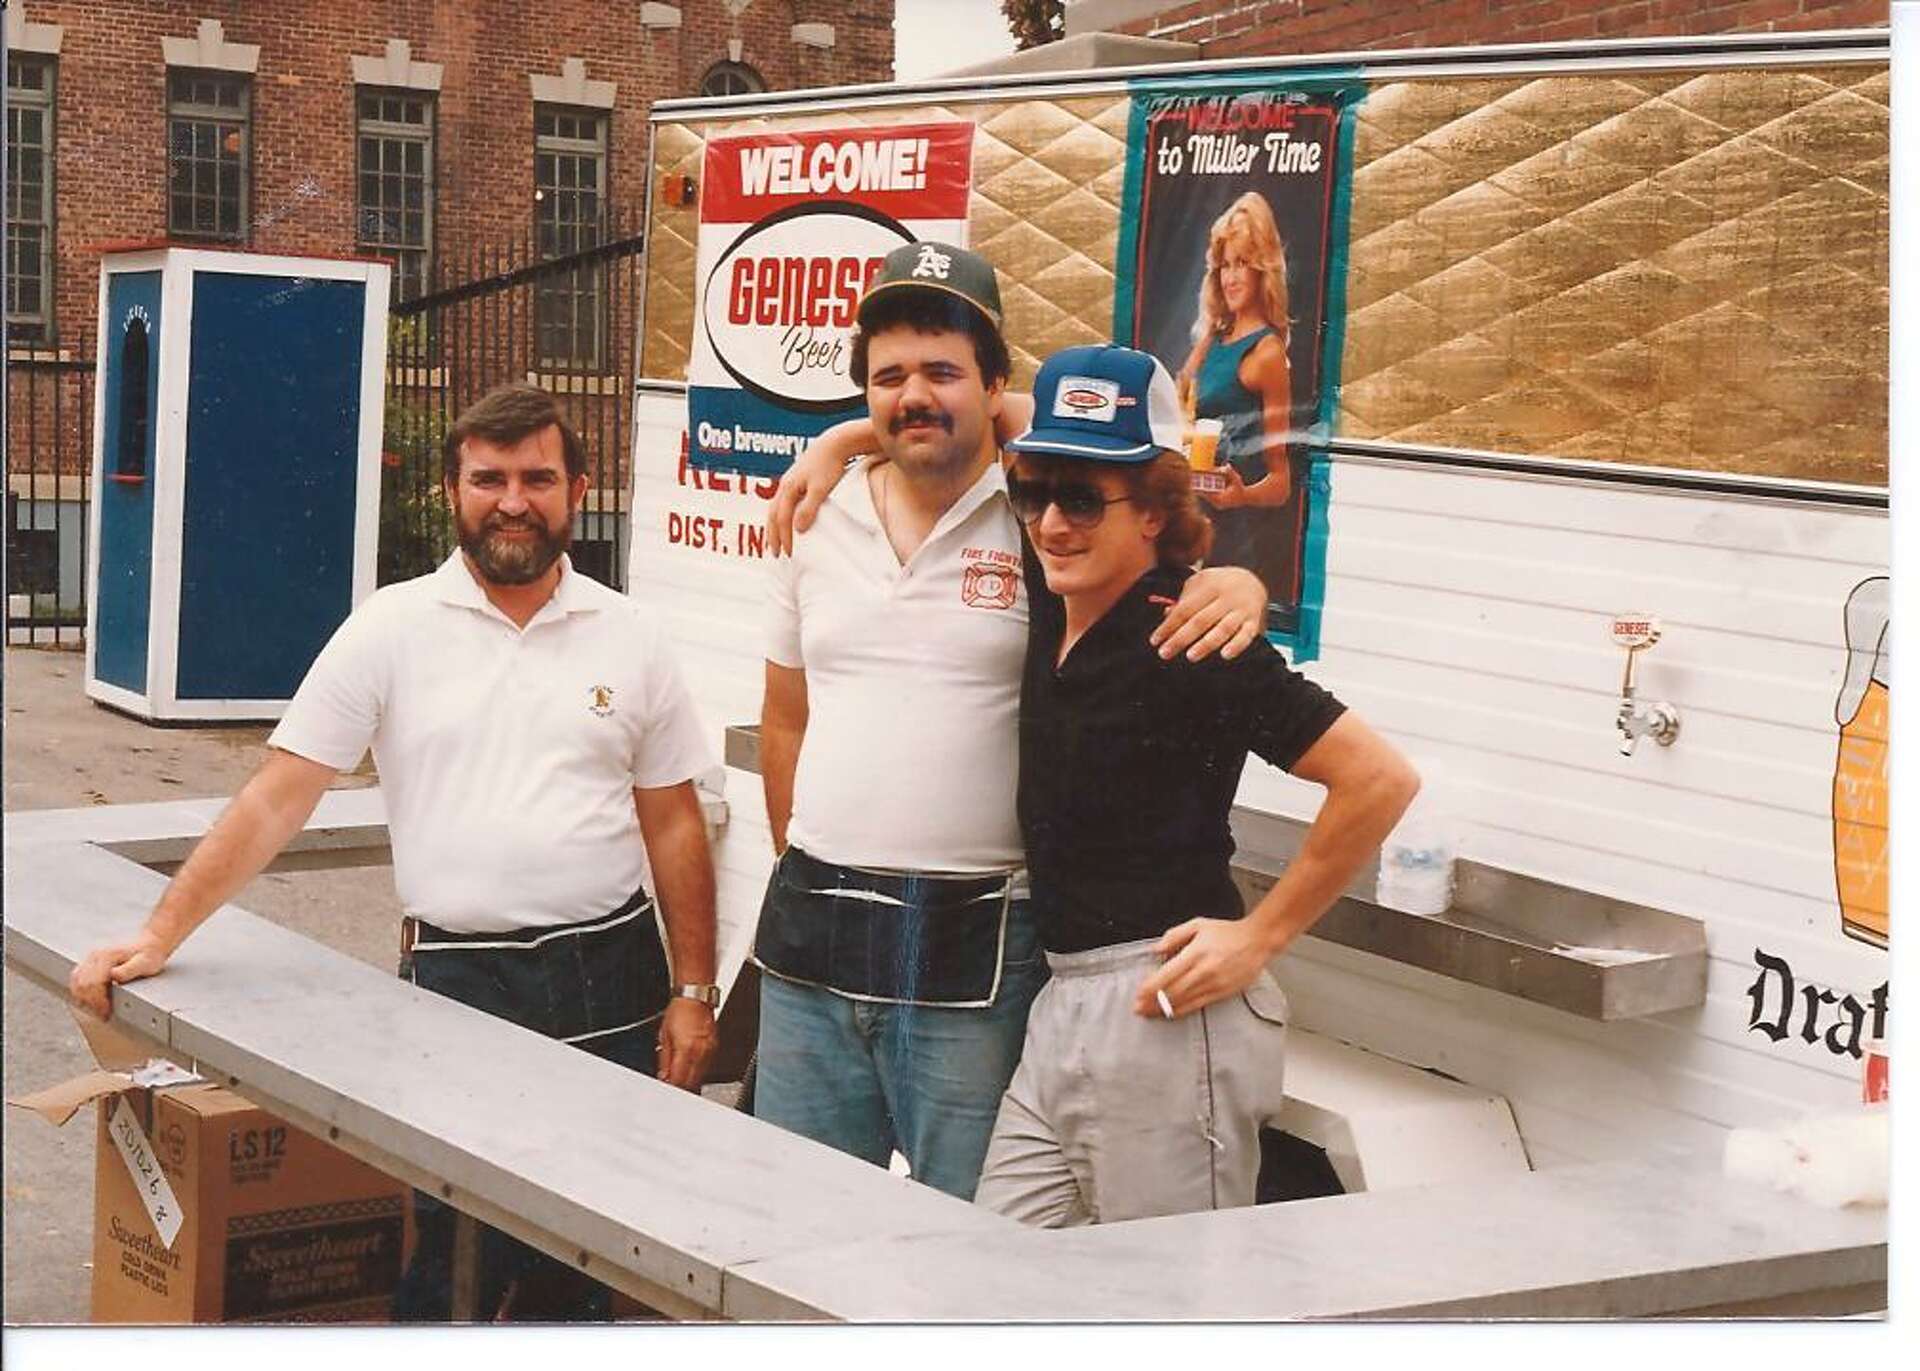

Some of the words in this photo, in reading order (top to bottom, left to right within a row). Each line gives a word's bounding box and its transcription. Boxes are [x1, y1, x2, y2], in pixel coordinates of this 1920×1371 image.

[739, 138, 929, 196] WELCOME!
[1157, 137, 1183, 175] to
[1188, 133, 1260, 175] Miller
[1264, 132, 1321, 174] Time
[780, 318, 845, 375] Beer
[698, 422, 732, 449] One
[734, 424, 806, 459] brewery
[669, 511, 728, 554] DIST.
[738, 523, 769, 559] IN
[264, 1126, 287, 1158] 12
